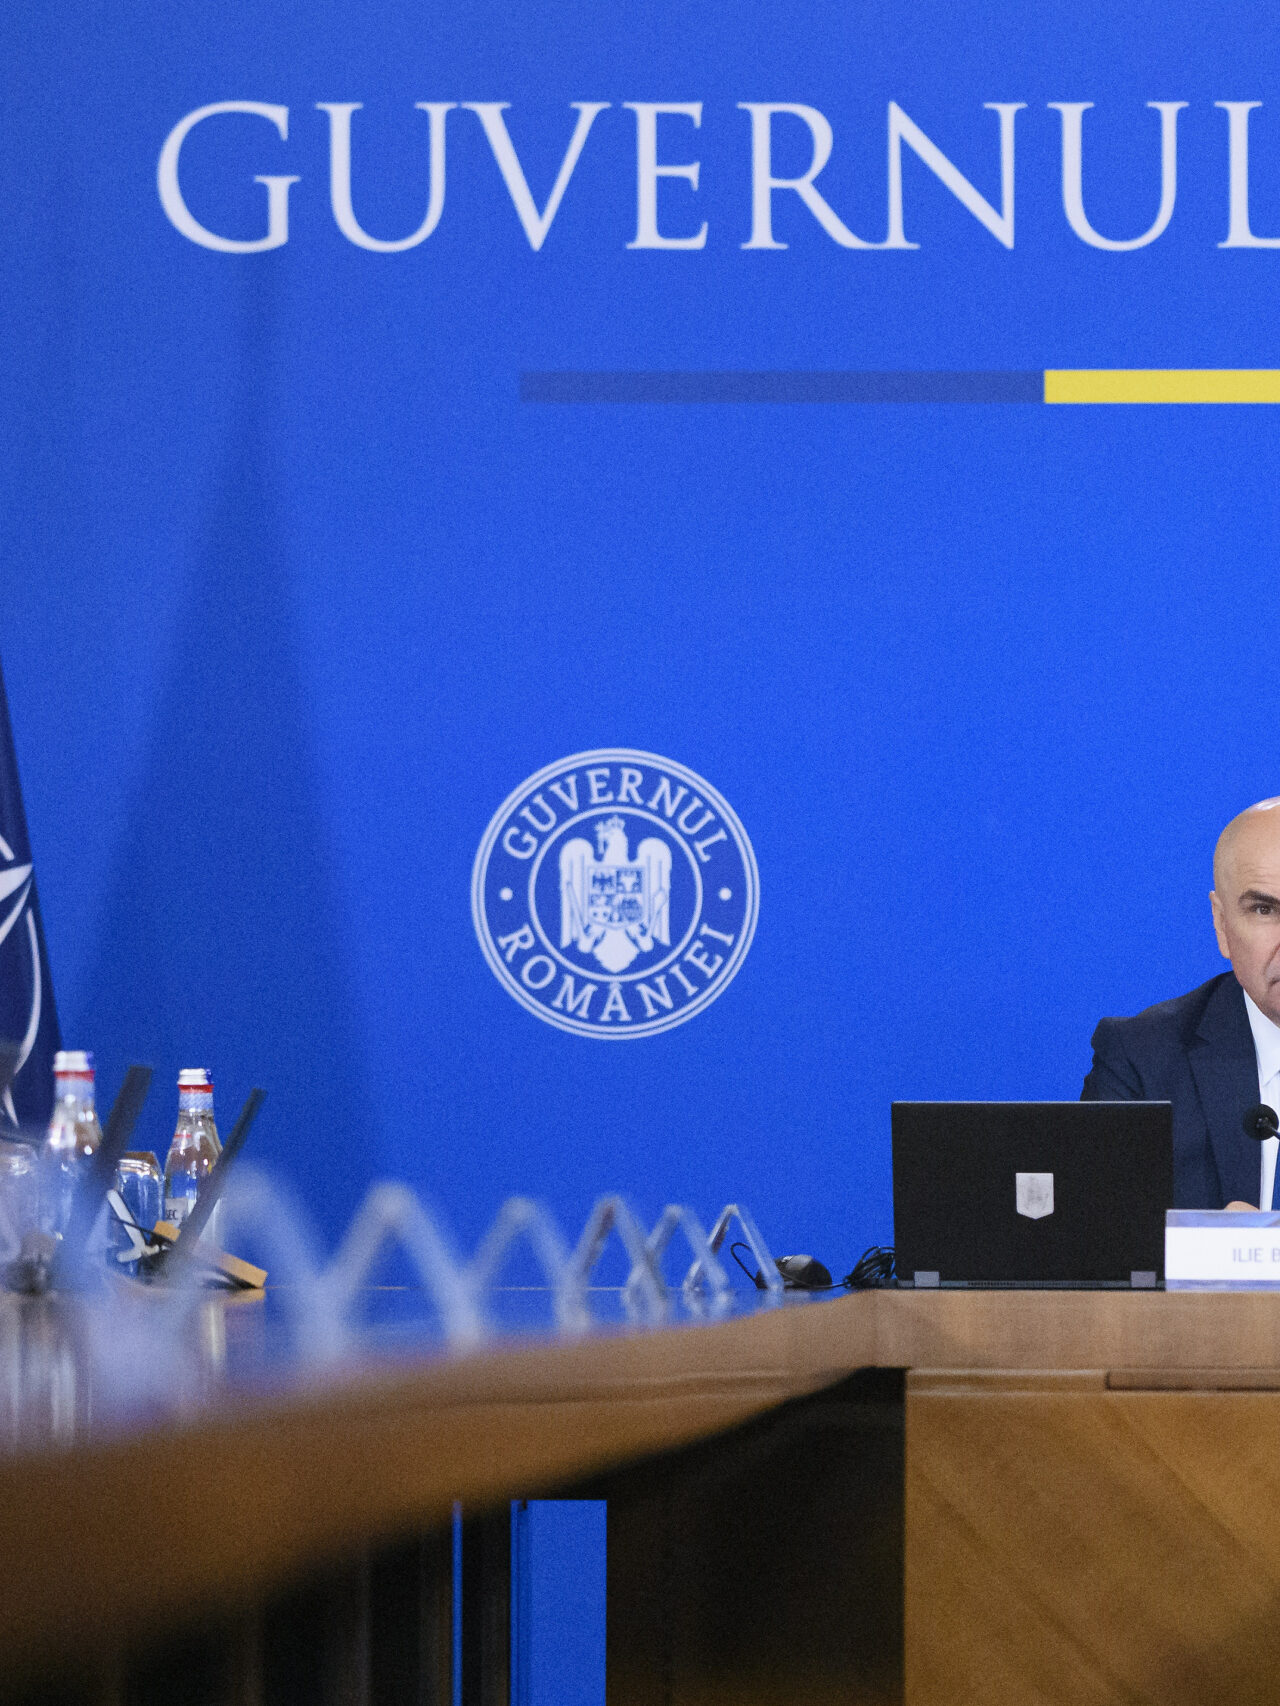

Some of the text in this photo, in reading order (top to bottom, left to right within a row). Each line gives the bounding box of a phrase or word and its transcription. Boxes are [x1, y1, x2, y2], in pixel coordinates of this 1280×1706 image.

[502, 767, 728, 863] GUVERNUL
[498, 923, 735, 1022] ROMÂNIEI
[1232, 1247, 1263, 1262] ILIE
